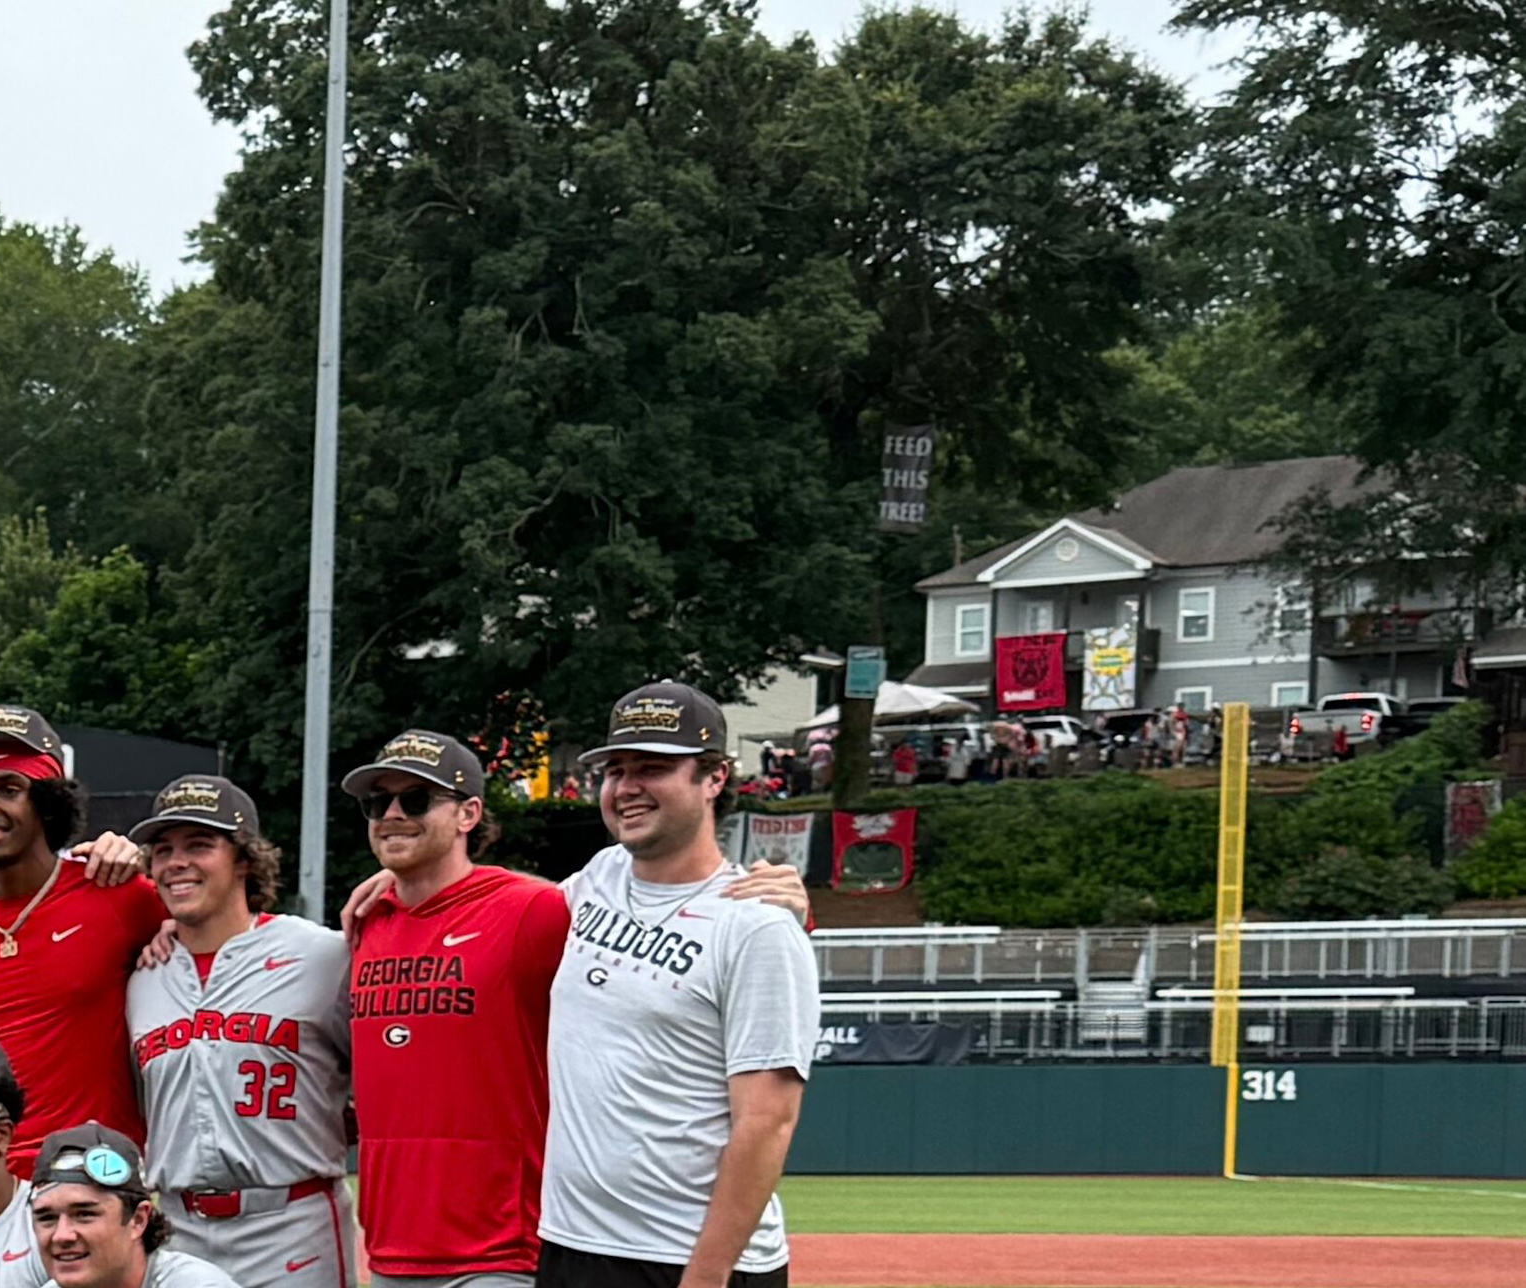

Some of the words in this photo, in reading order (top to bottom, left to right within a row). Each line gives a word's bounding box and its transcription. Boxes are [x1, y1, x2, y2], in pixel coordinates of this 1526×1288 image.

[885, 436, 932, 456] FEED
[883, 468, 928, 489] THIS
[879, 502, 925, 522] TREE!
[357, 956, 463, 987] GEORGIA
[587, 968, 608, 986] G
[385, 1024, 410, 1046] G
[235, 1060, 297, 1120] 32
[1242, 1070, 1297, 1100] 314
